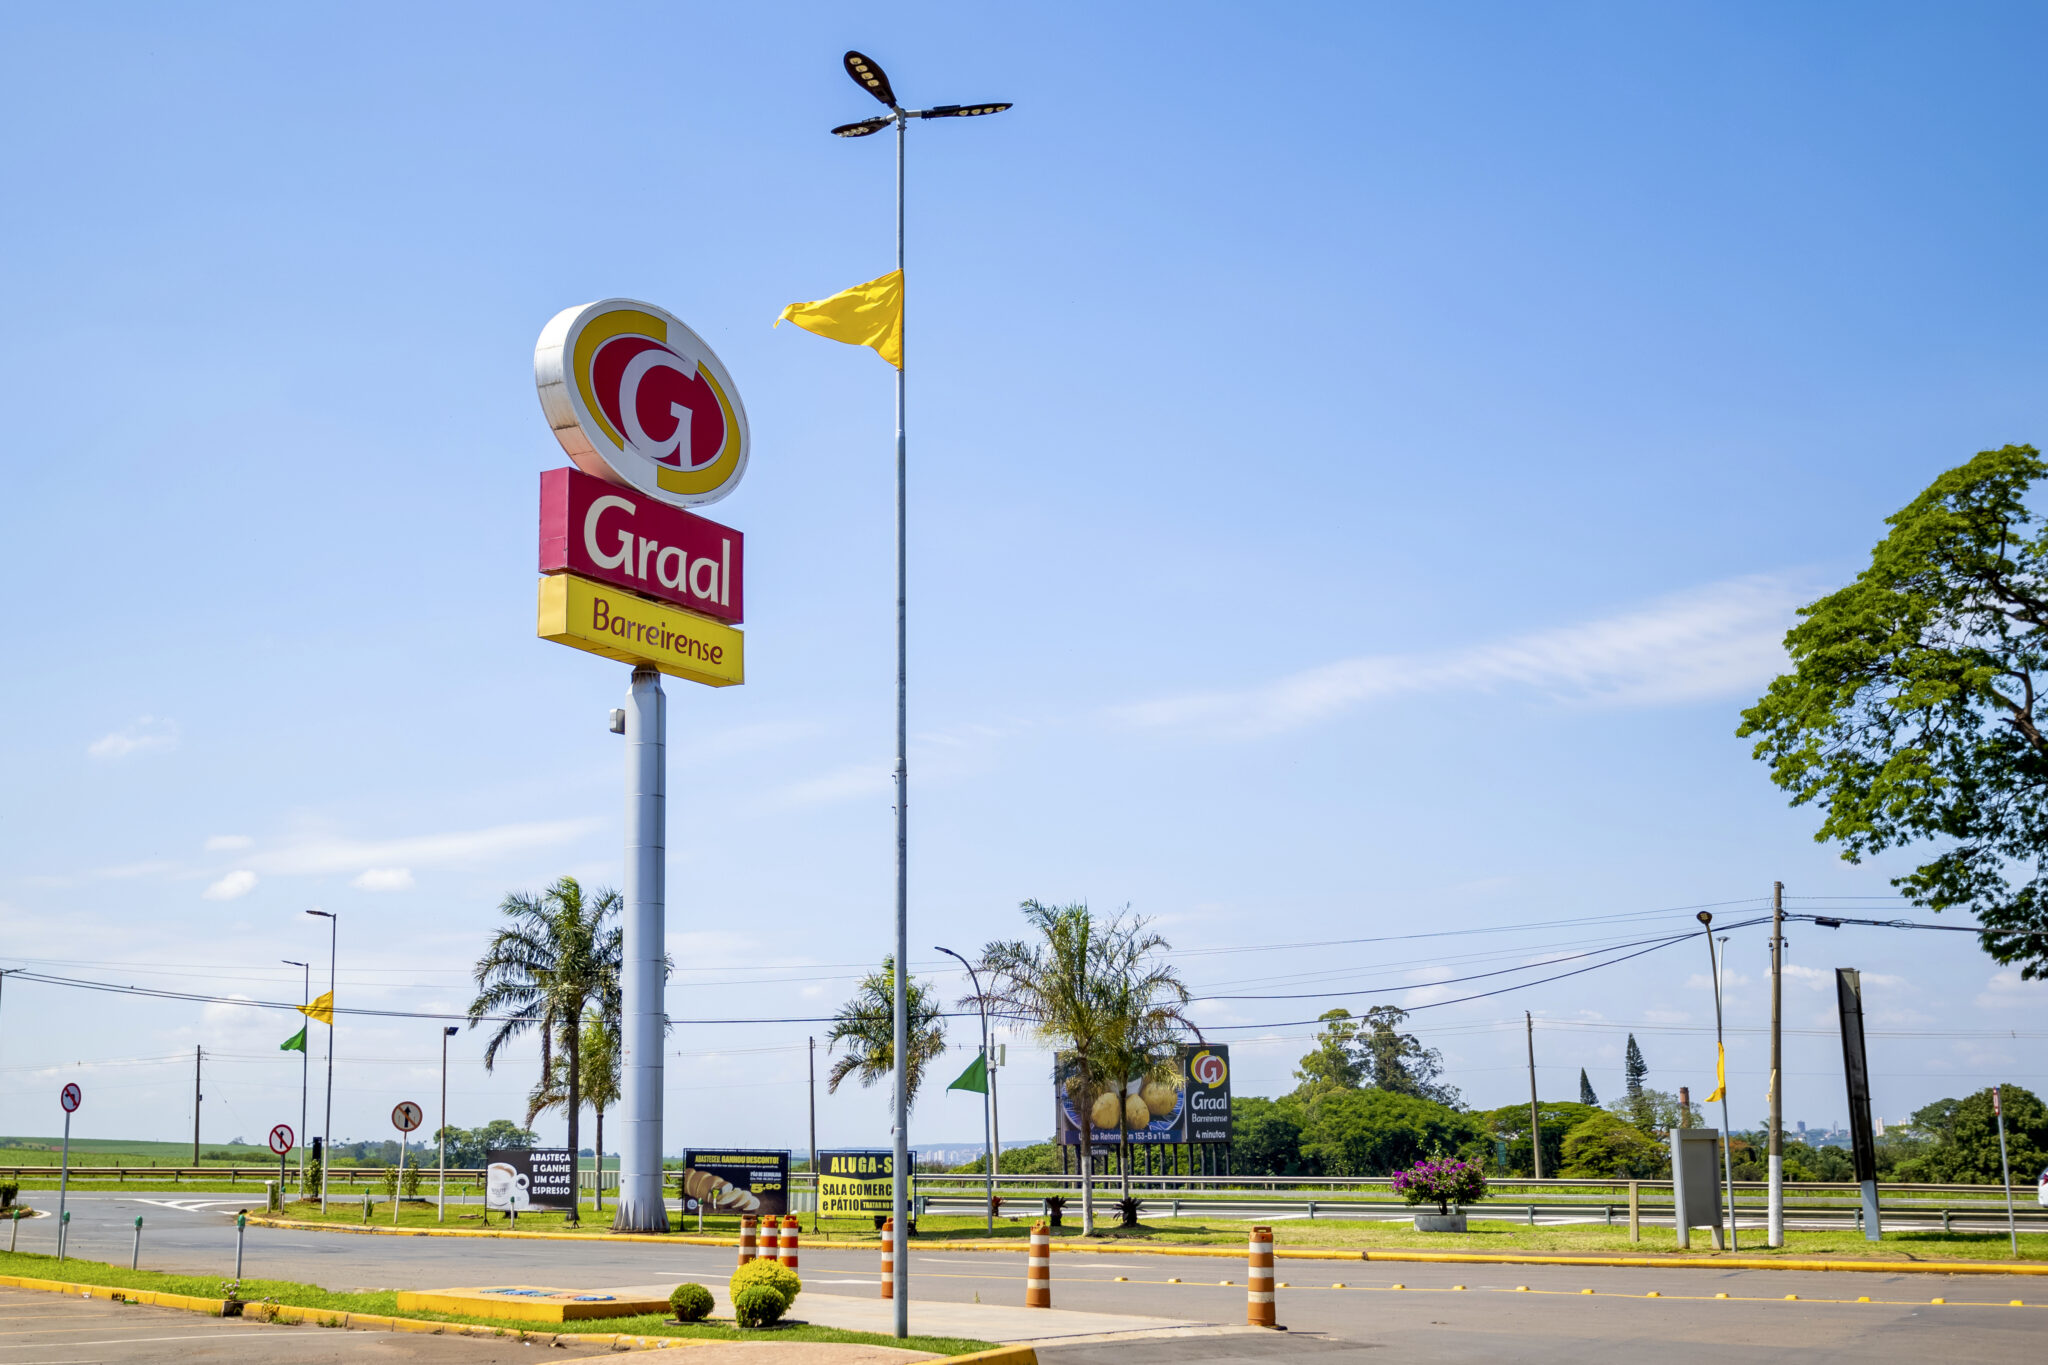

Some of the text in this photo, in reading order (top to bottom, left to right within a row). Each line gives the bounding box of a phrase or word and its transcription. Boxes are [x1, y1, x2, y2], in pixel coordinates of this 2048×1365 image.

[583, 494, 731, 607] Graal
[592, 597, 724, 665] Barreirense
[1191, 1091, 1228, 1110] Graal
[1191, 1112, 1228, 1123] Barreirense
[1161, 1131, 1171, 1140] km
[1195, 1130, 1226, 1139] 4 minutos
[529, 1153, 571, 1163] ABASTEÇA
[746, 1156, 779, 1165] DESCONTO!
[533, 1164, 571, 1173] E GANHE
[830, 1156, 893, 1174] ALUGA-S
[534, 1174, 571, 1184] UM CAFÉ
[532, 1186, 571, 1195] ESPRESSO
[822, 1183, 893, 1196] SALA COMERC
[822, 1197, 860, 1211] e PÁTIO
